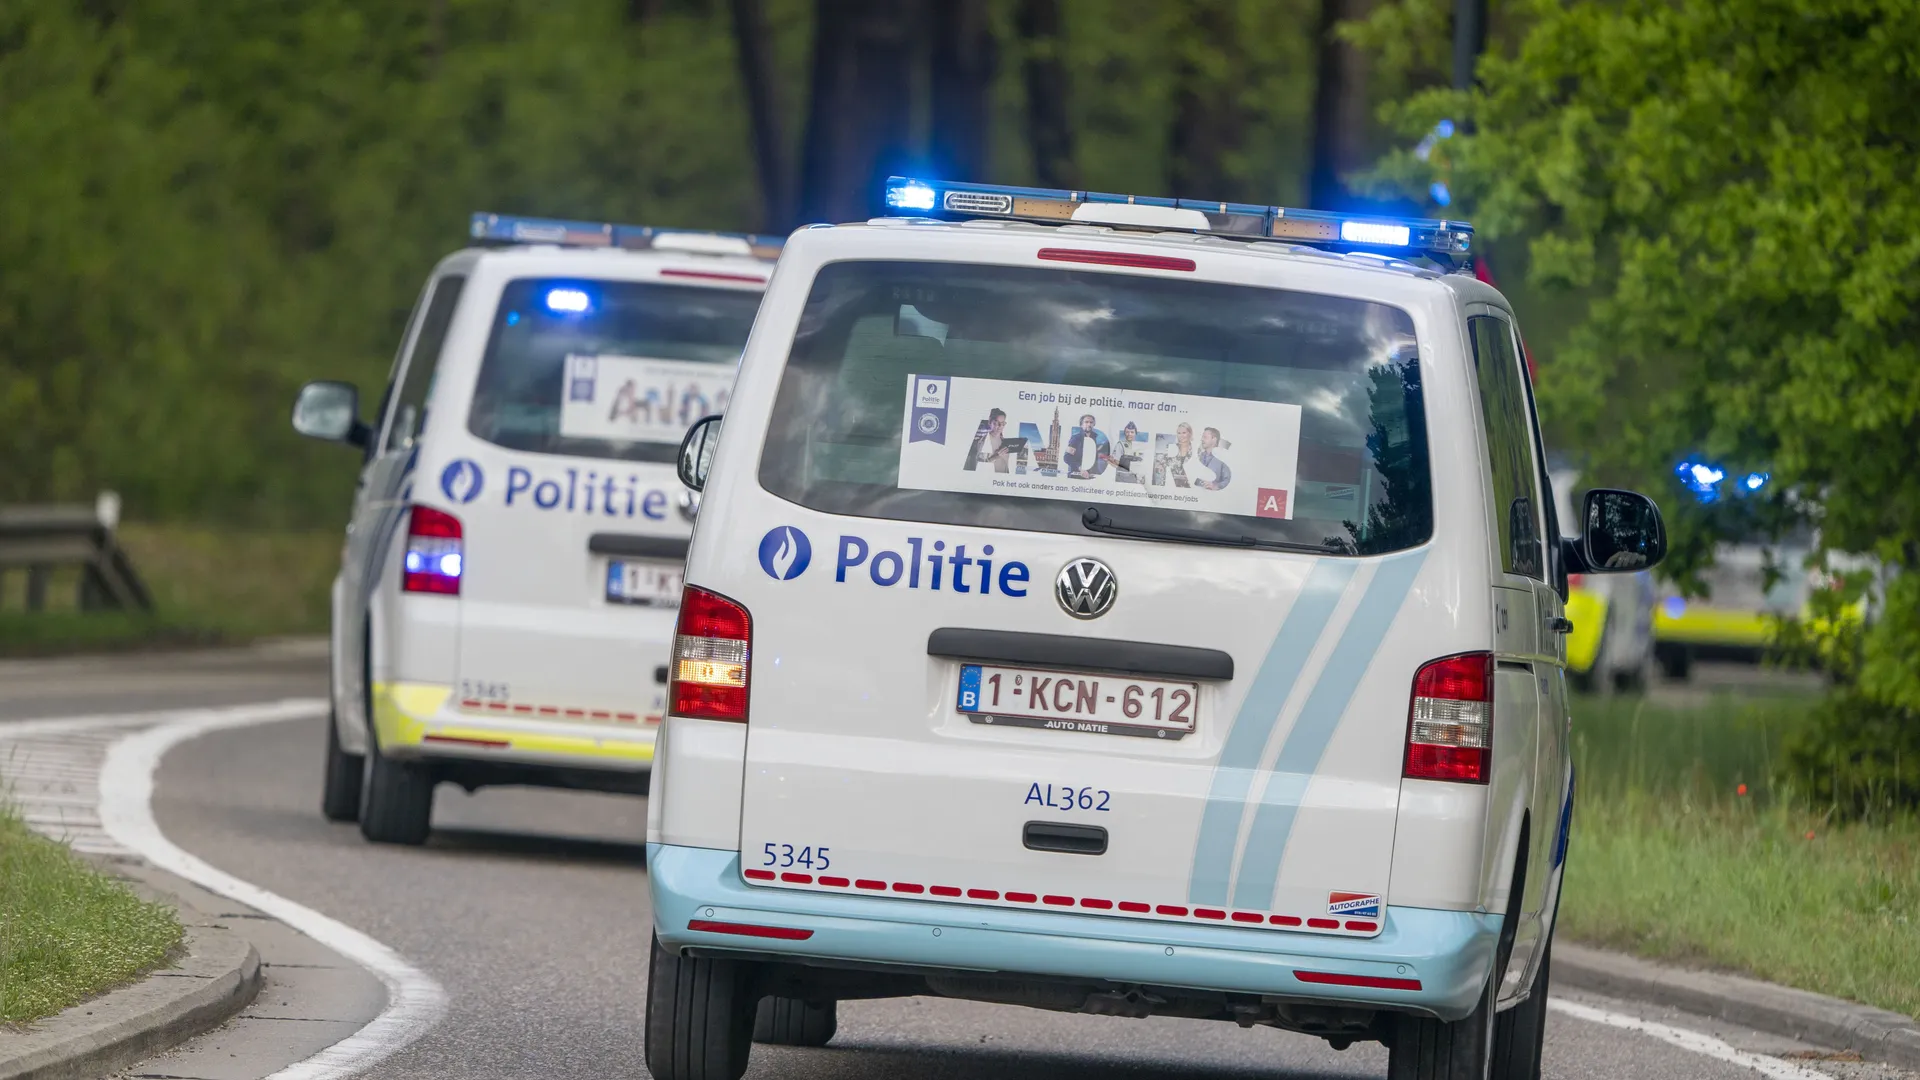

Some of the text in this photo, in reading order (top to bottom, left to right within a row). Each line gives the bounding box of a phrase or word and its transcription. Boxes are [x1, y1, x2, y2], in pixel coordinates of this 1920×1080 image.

[1018, 390, 1037, 401] Een
[1038, 391, 1056, 404] job
[1058, 393, 1072, 406] bij
[1074, 395, 1087, 405] de
[1128, 401, 1155, 410] maar
[1157, 404, 1177, 413] dan
[963, 413, 1232, 491] ANDERS
[504, 466, 668, 521] Politie
[1071, 486, 1105, 495] Solliciteer
[1263, 495, 1279, 512] A
[836, 535, 1030, 597] Politie
[962, 691, 976, 707] B
[1077, 723, 1109, 733] NATIE
[1024, 782, 1111, 812] AL362
[763, 843, 830, 870] 5345
[1329, 898, 1379, 911] AUTOGRAPHE
